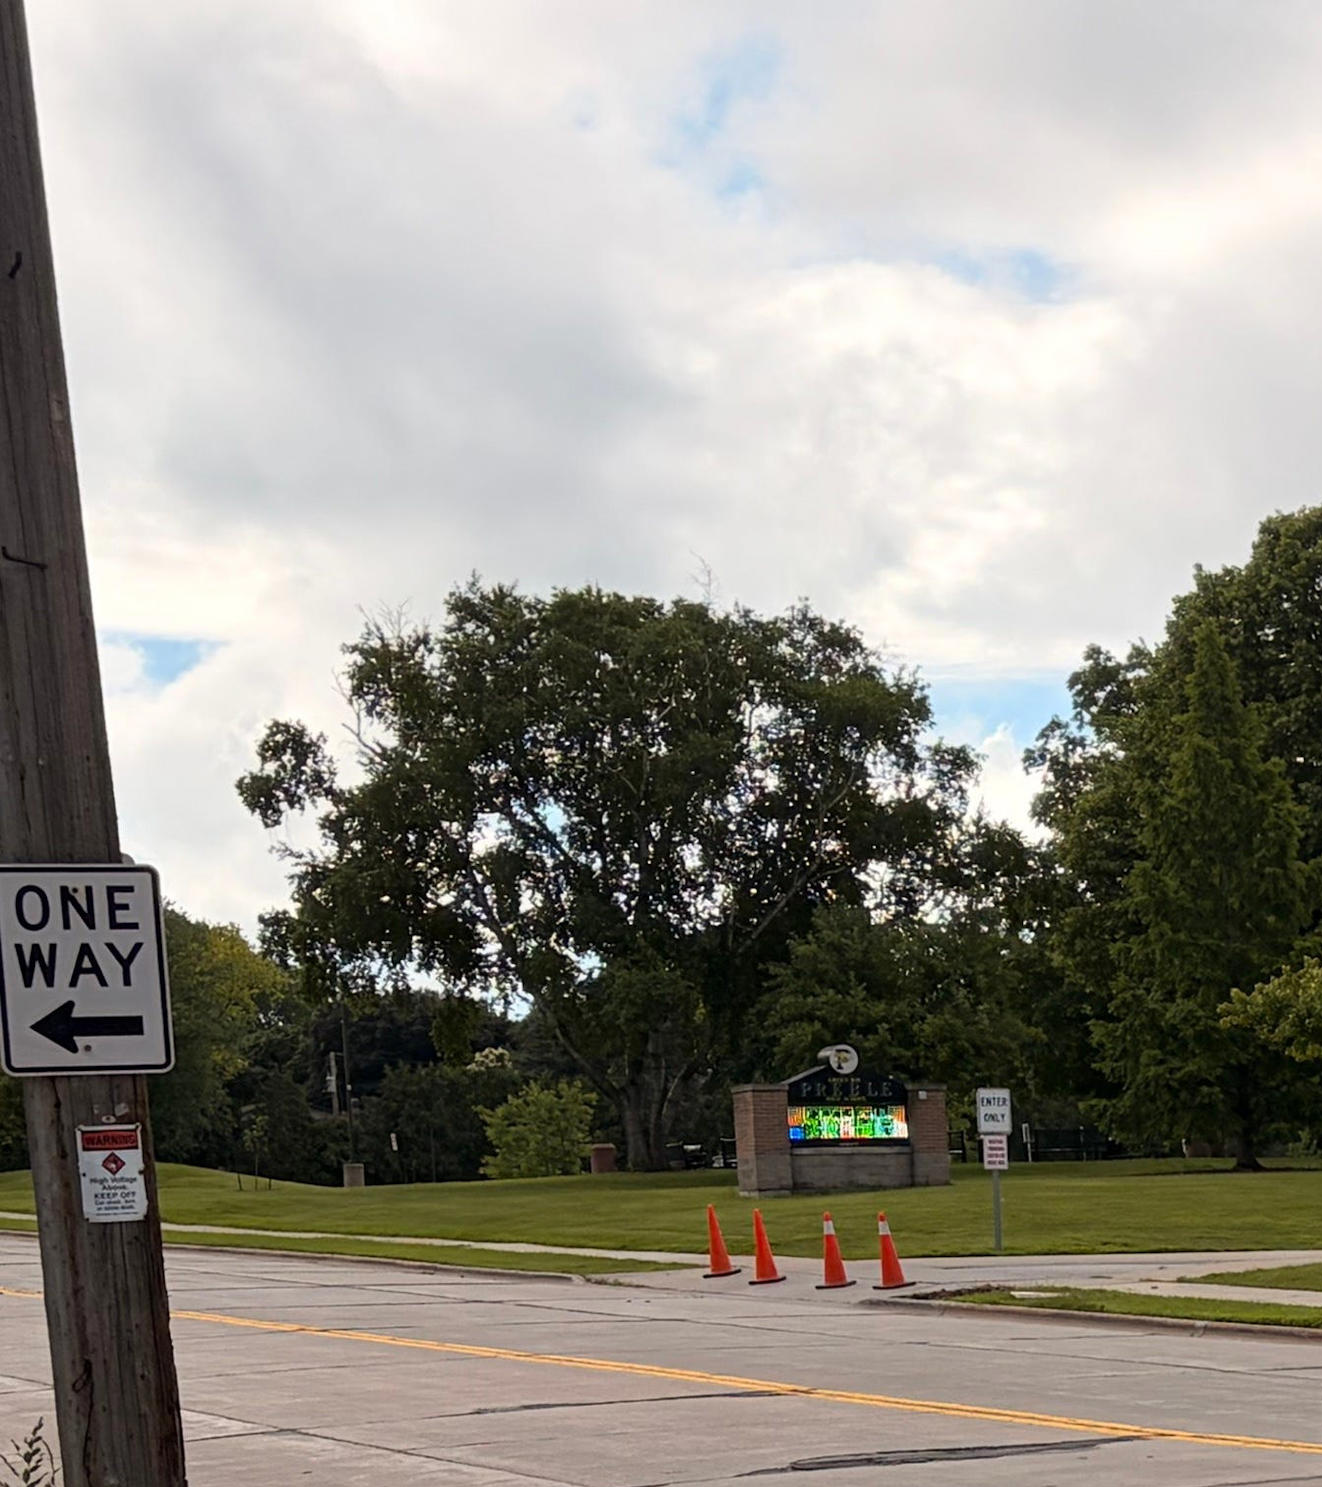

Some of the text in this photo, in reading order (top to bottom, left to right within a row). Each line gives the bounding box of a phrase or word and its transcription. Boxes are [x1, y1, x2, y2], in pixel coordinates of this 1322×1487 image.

[15, 884, 140, 931] ONE
[14, 942, 144, 989] WAY
[981, 1097, 1008, 1107] ENTER
[984, 1113, 1006, 1123] ONLY
[84, 1132, 136, 1146] WARNING
[111, 1176, 138, 1184] Voltage
[120, 1191, 137, 1199] OFF
